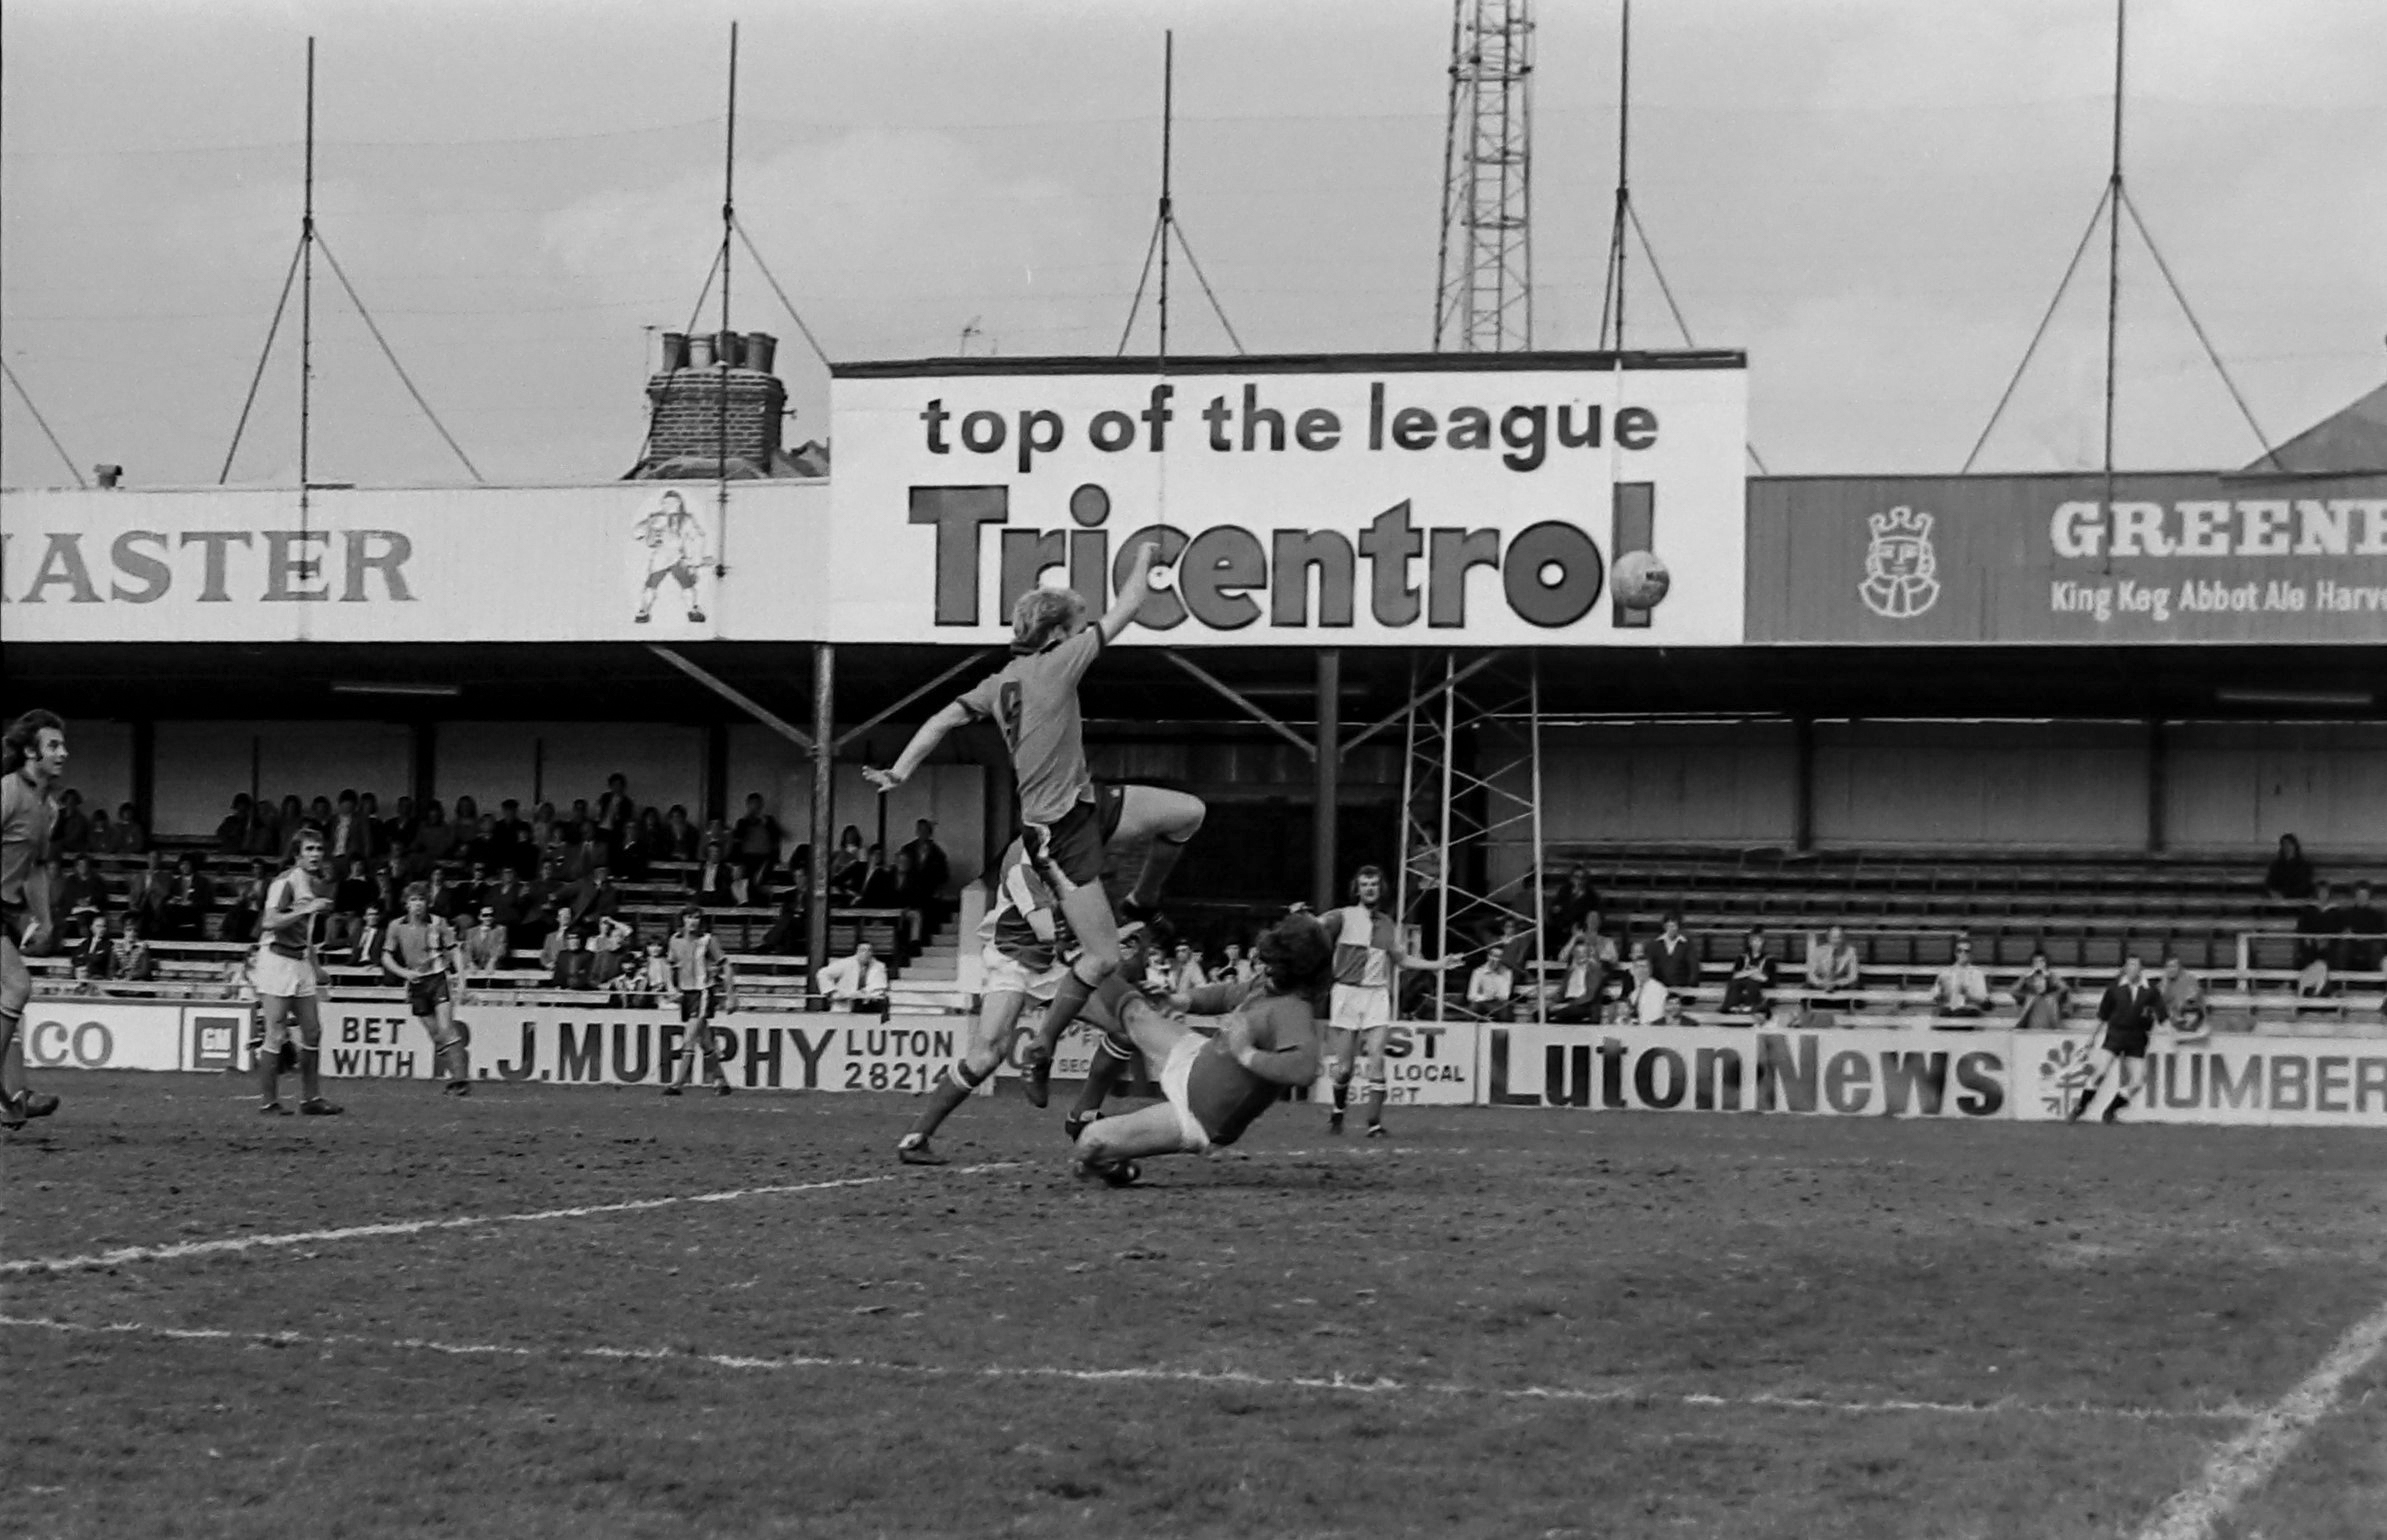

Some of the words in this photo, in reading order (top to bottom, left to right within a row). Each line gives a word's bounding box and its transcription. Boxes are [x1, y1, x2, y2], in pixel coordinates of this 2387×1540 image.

[921, 398, 1064, 473] top
[1089, 384, 1174, 453] of
[1203, 384, 1343, 453] the
[1368, 382, 1660, 472] league
[1, 530, 419, 604] ASTER
[908, 482, 1655, 630] Tricentrol
[2051, 580, 2113, 622] King
[2117, 580, 2171, 622] Keg
[2178, 579, 2260, 612] Abbot
[2263, 579, 2307, 612] Ale
[1000, 681, 1023, 748] 9
[342, 1016, 407, 1045] BET
[846, 1029, 953, 1058] LUTON
[333, 1048, 414, 1078] WITH
[1393, 1063, 1466, 1082] LOCAL
[1347, 1086, 1421, 1104] SPRT
